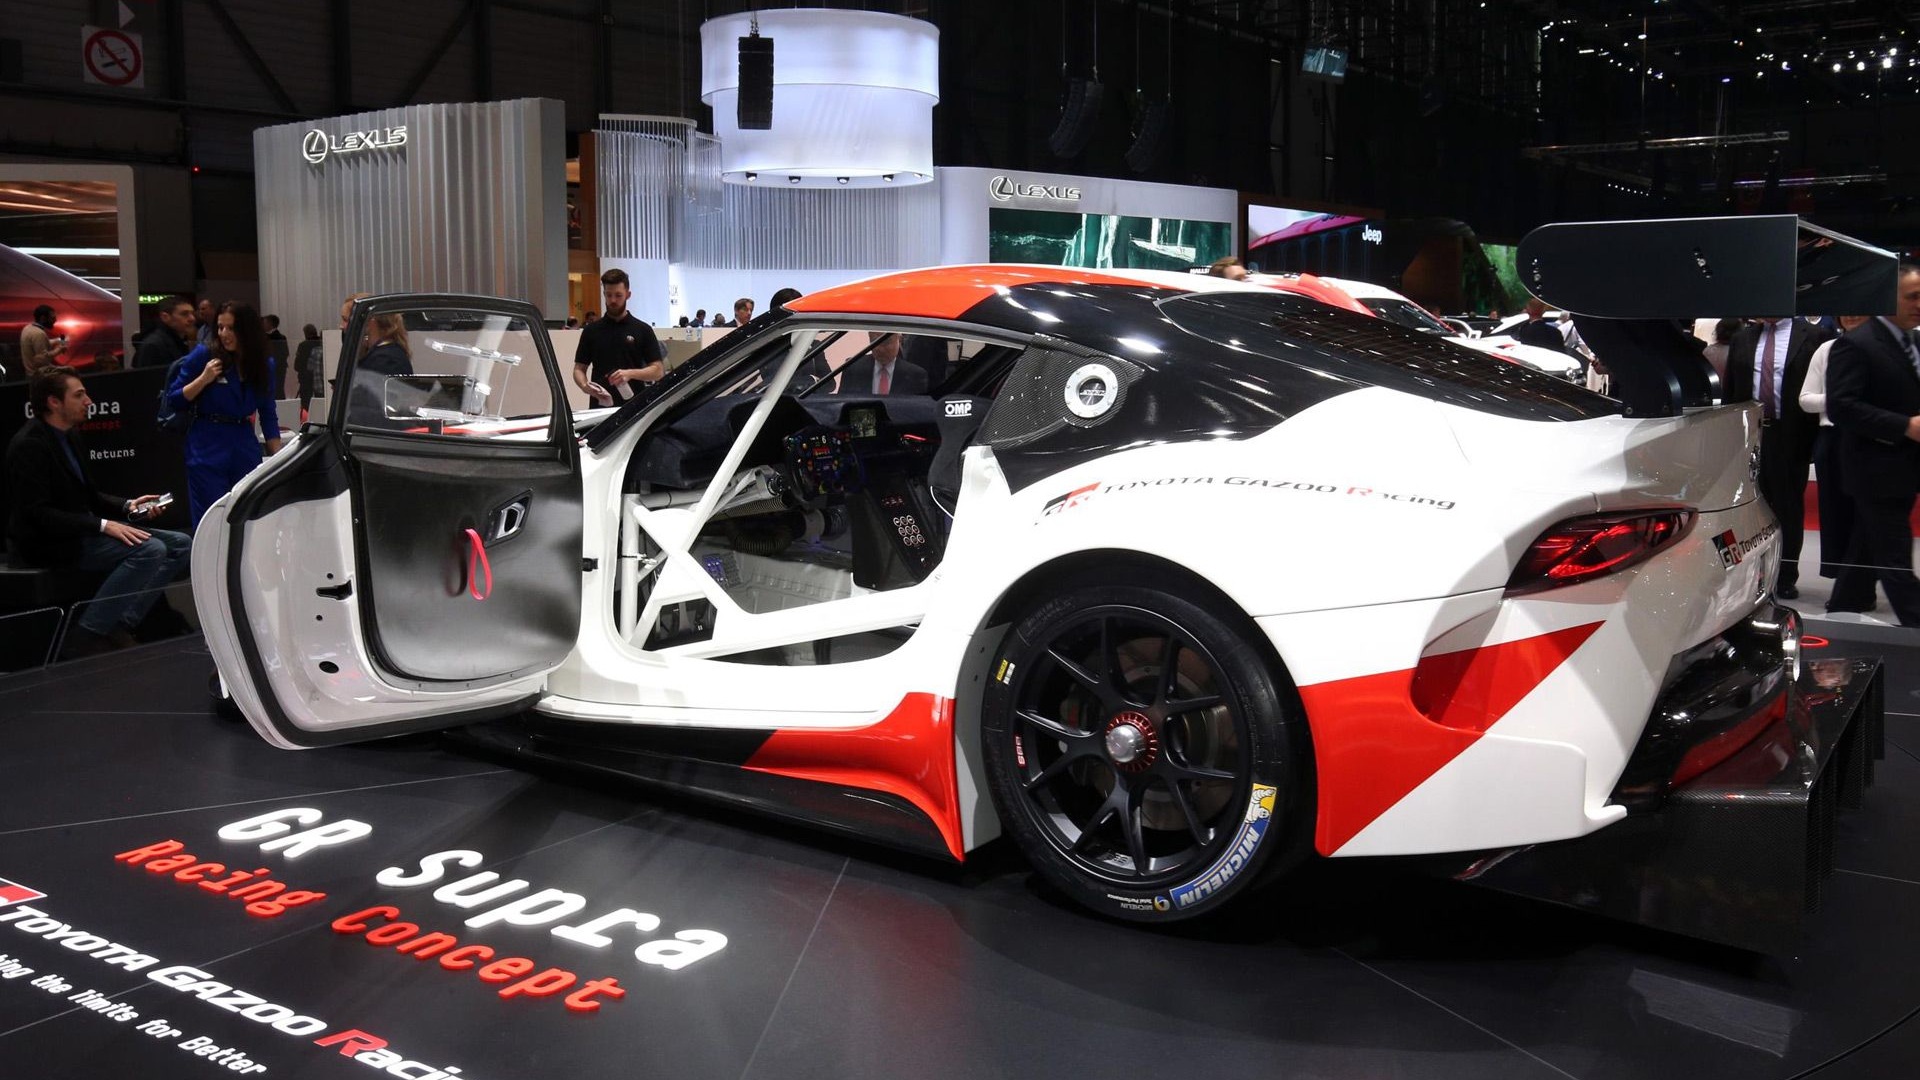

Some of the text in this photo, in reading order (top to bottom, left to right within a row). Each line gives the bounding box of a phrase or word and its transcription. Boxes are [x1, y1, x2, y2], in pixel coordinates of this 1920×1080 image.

[329, 125, 408, 153] LEXUS
[1016, 183, 1082, 201] LEXUS
[1362, 225, 1382, 245] Jeep
[24, 401, 121, 419] G pra
[945, 402, 972, 415] OMP
[90, 449, 136, 461] Returns
[1104, 476, 1214, 494] TOYOTA
[1223, 476, 1337, 493] GAZOO
[1180, 827, 1260, 906] MICHELIN
[217, 807, 728, 970] GR Supra
[1120, 903, 1153, 911] MICHELIN
[114, 839, 626, 1012] Racing Concept
[0, 905, 463, 1080] TOYOTA GAZOO Raci
[31, 974, 72, 994] the
[67, 989, 139, 1022] limits
[136, 1019, 182, 1038] for
[178, 1036, 267, 1075] Better
